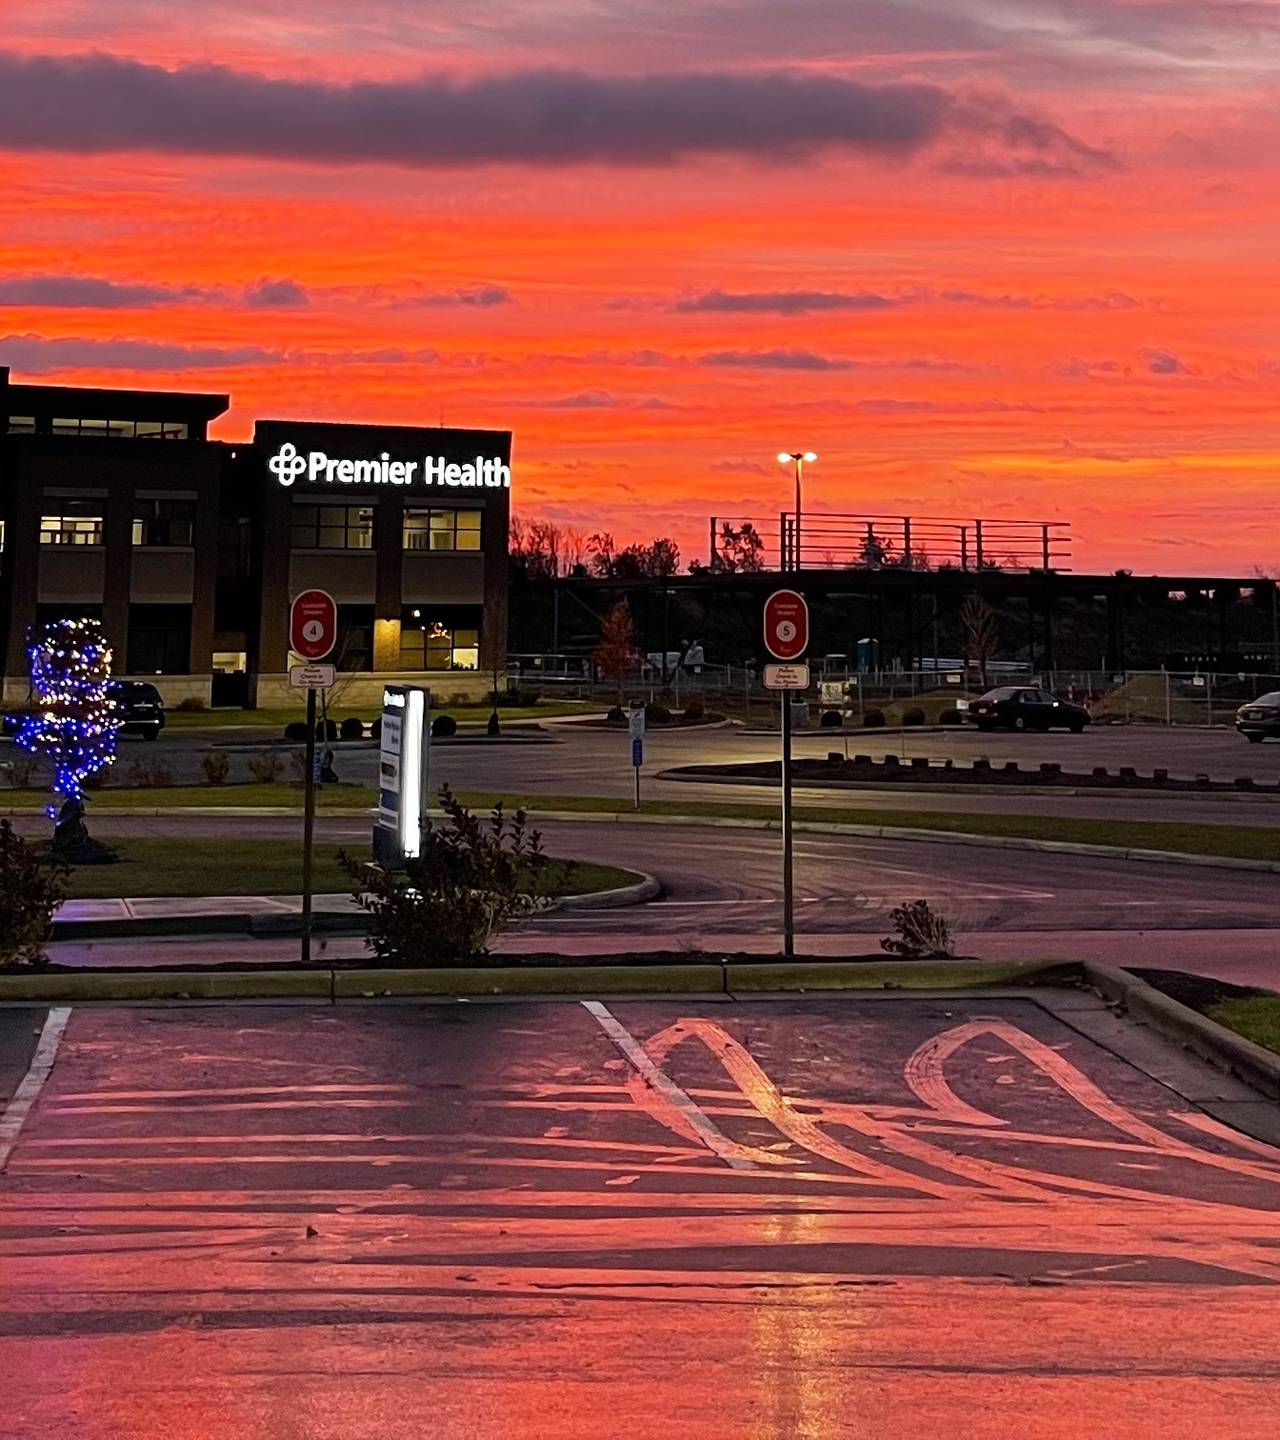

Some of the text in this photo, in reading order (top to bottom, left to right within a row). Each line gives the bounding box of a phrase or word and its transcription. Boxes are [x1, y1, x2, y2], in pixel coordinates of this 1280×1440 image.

[309, 452, 511, 487] Premier Health
[309, 625, 317, 636] 4
[783, 626, 791, 637] 5
